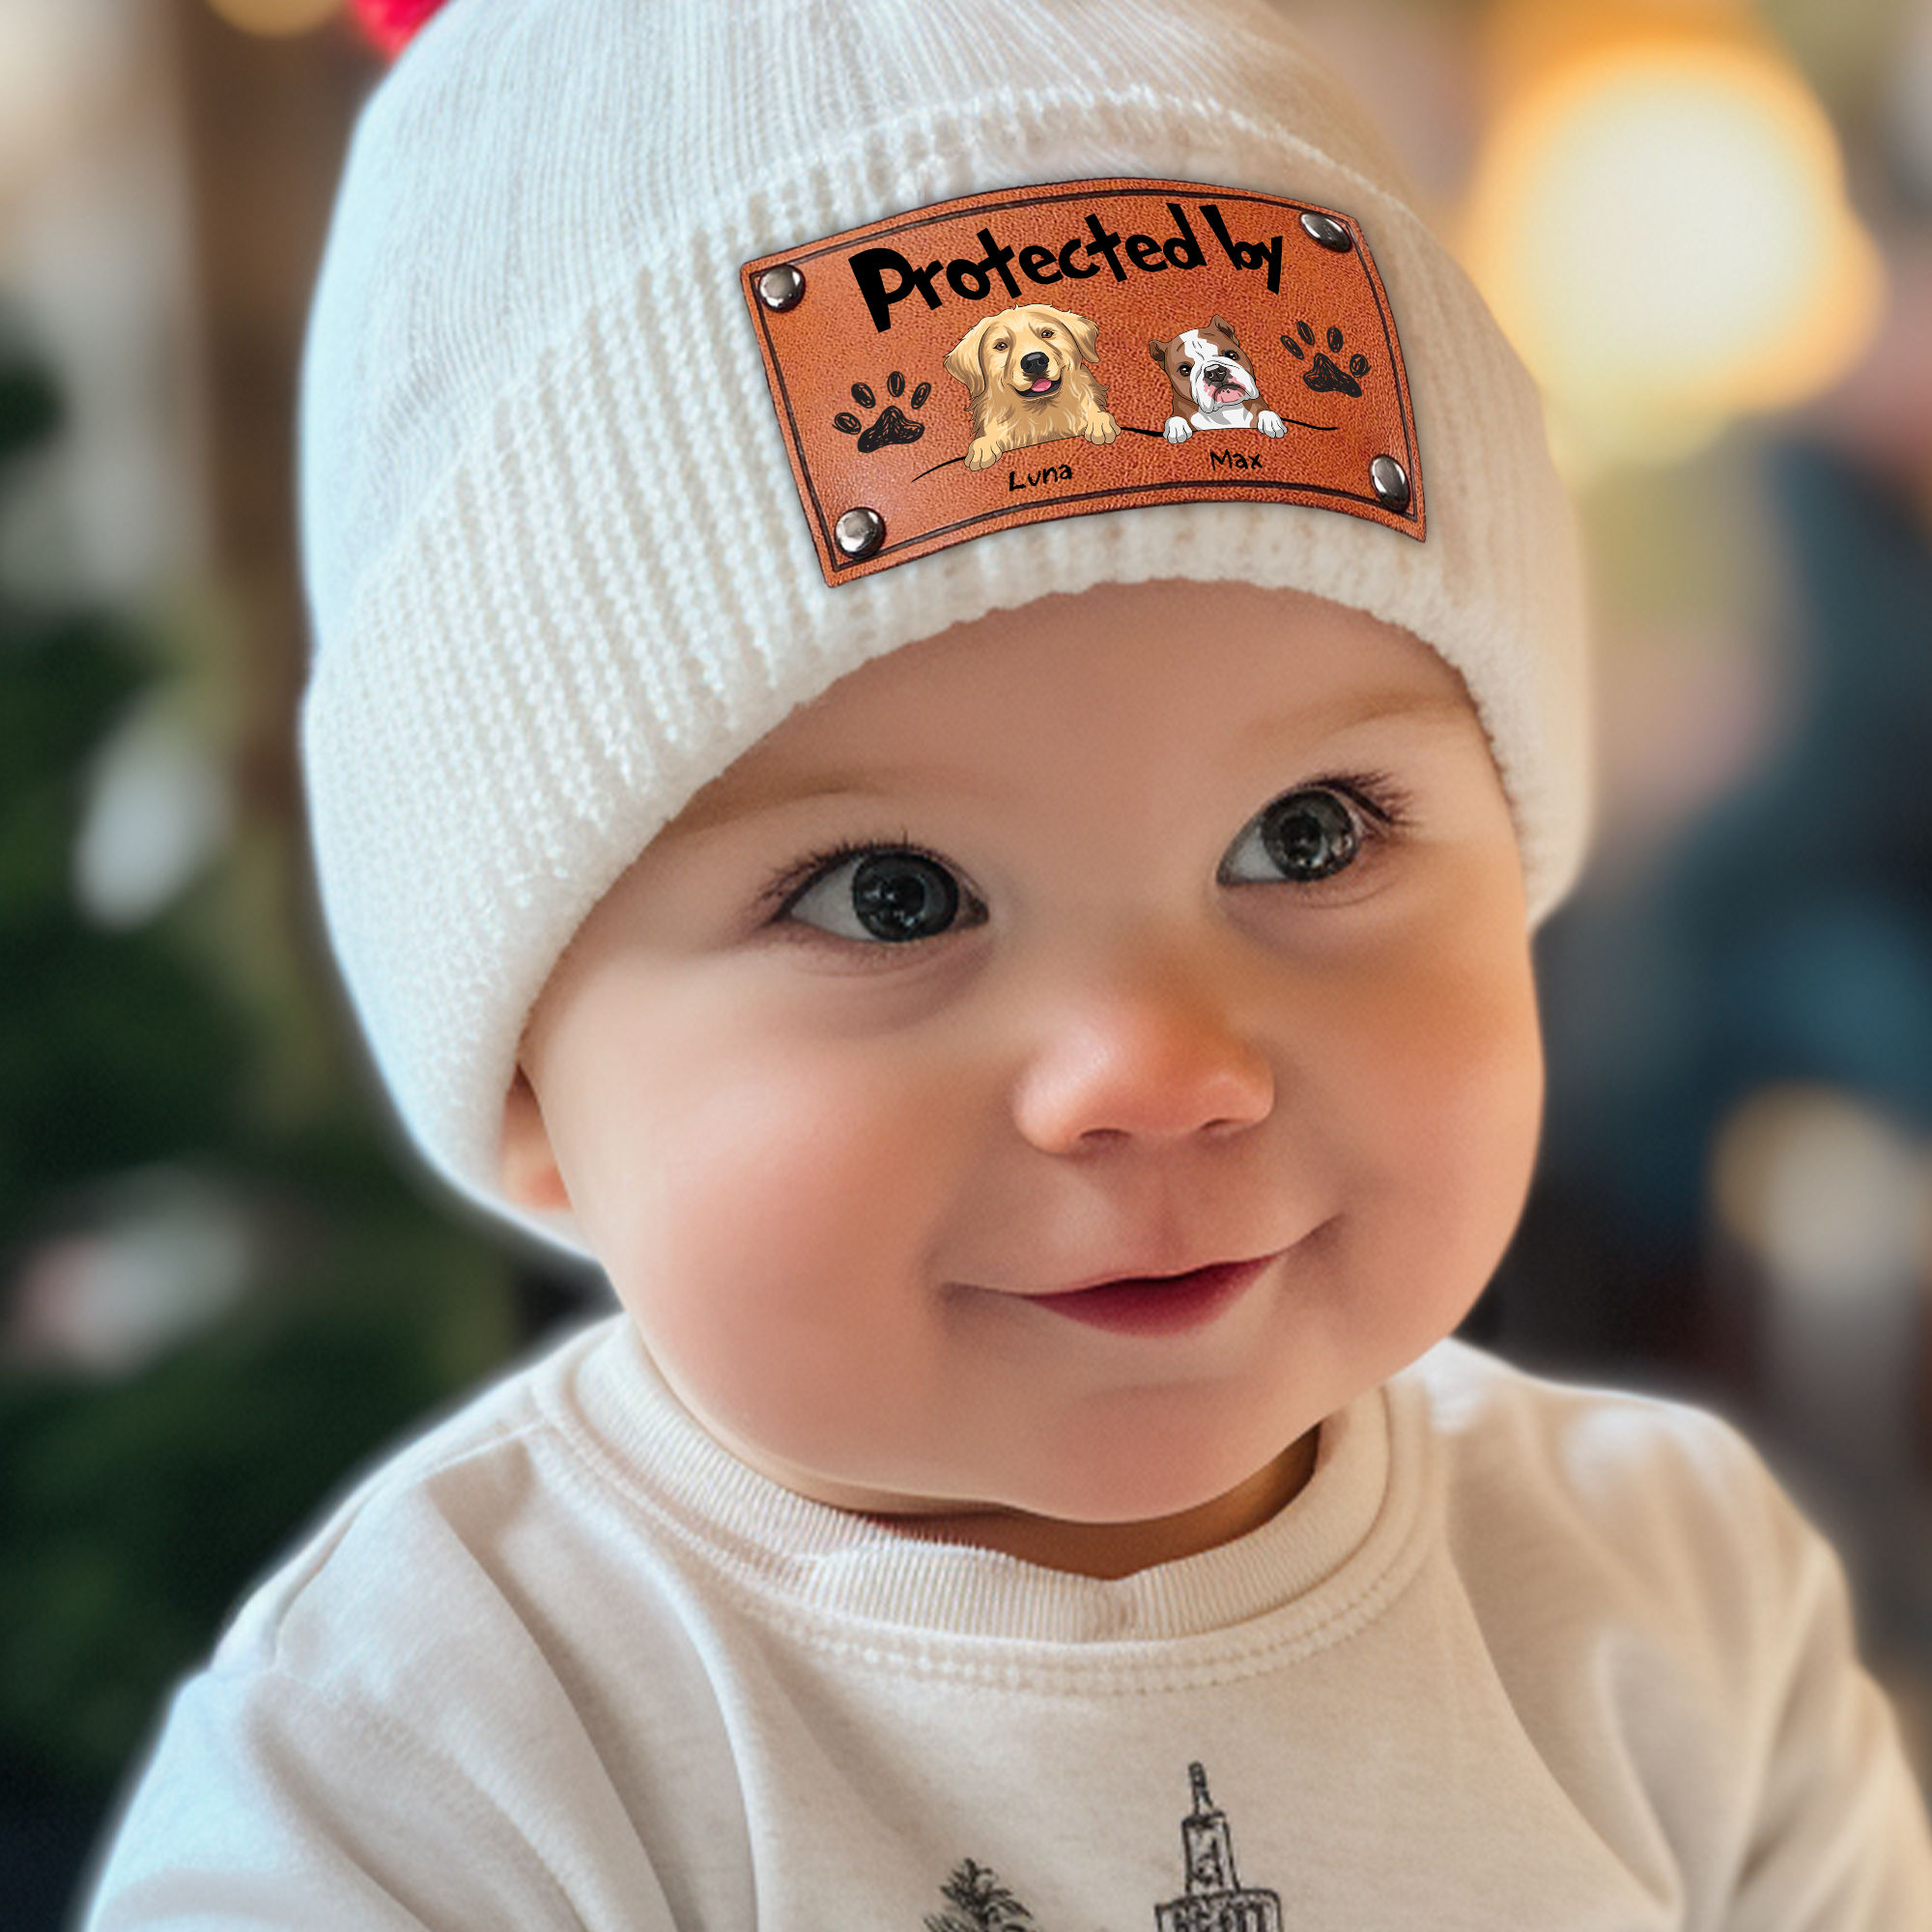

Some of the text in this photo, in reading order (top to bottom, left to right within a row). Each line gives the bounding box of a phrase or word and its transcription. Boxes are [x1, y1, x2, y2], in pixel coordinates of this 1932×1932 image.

[848, 202, 1283, 333] Protected by
[1209, 448, 1264, 471] Max
[1009, 464, 1073, 492] Luna
